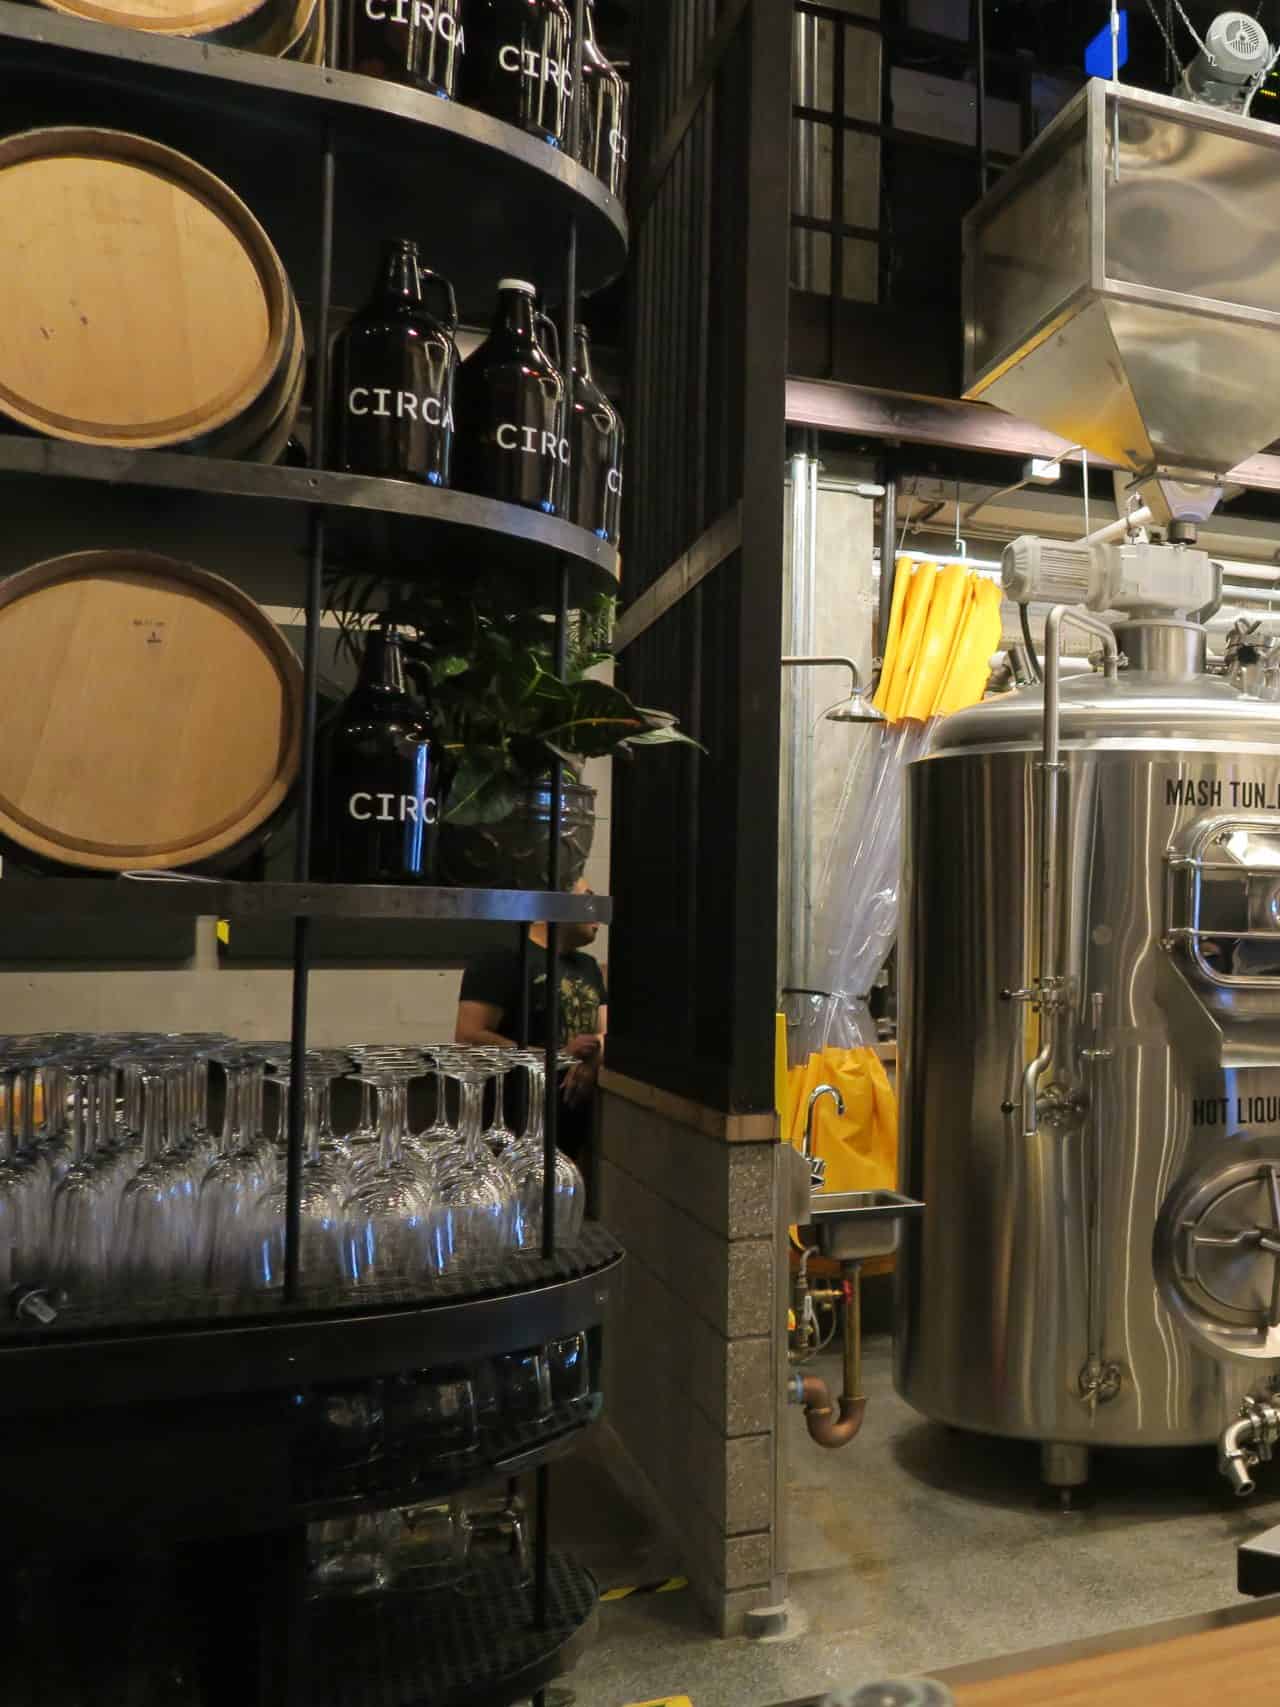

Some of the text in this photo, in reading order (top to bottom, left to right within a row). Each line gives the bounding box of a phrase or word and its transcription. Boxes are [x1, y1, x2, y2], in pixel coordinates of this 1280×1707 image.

[366, 0, 466, 55] CIRCA
[500, 45, 573, 98] CIRC
[349, 387, 455, 433] CIRCA
[496, 423, 571, 467] CIRC
[349, 792, 438, 825] CIRC
[1166, 779, 1222, 807] MASH
[1193, 1098, 1230, 1126] HOT
